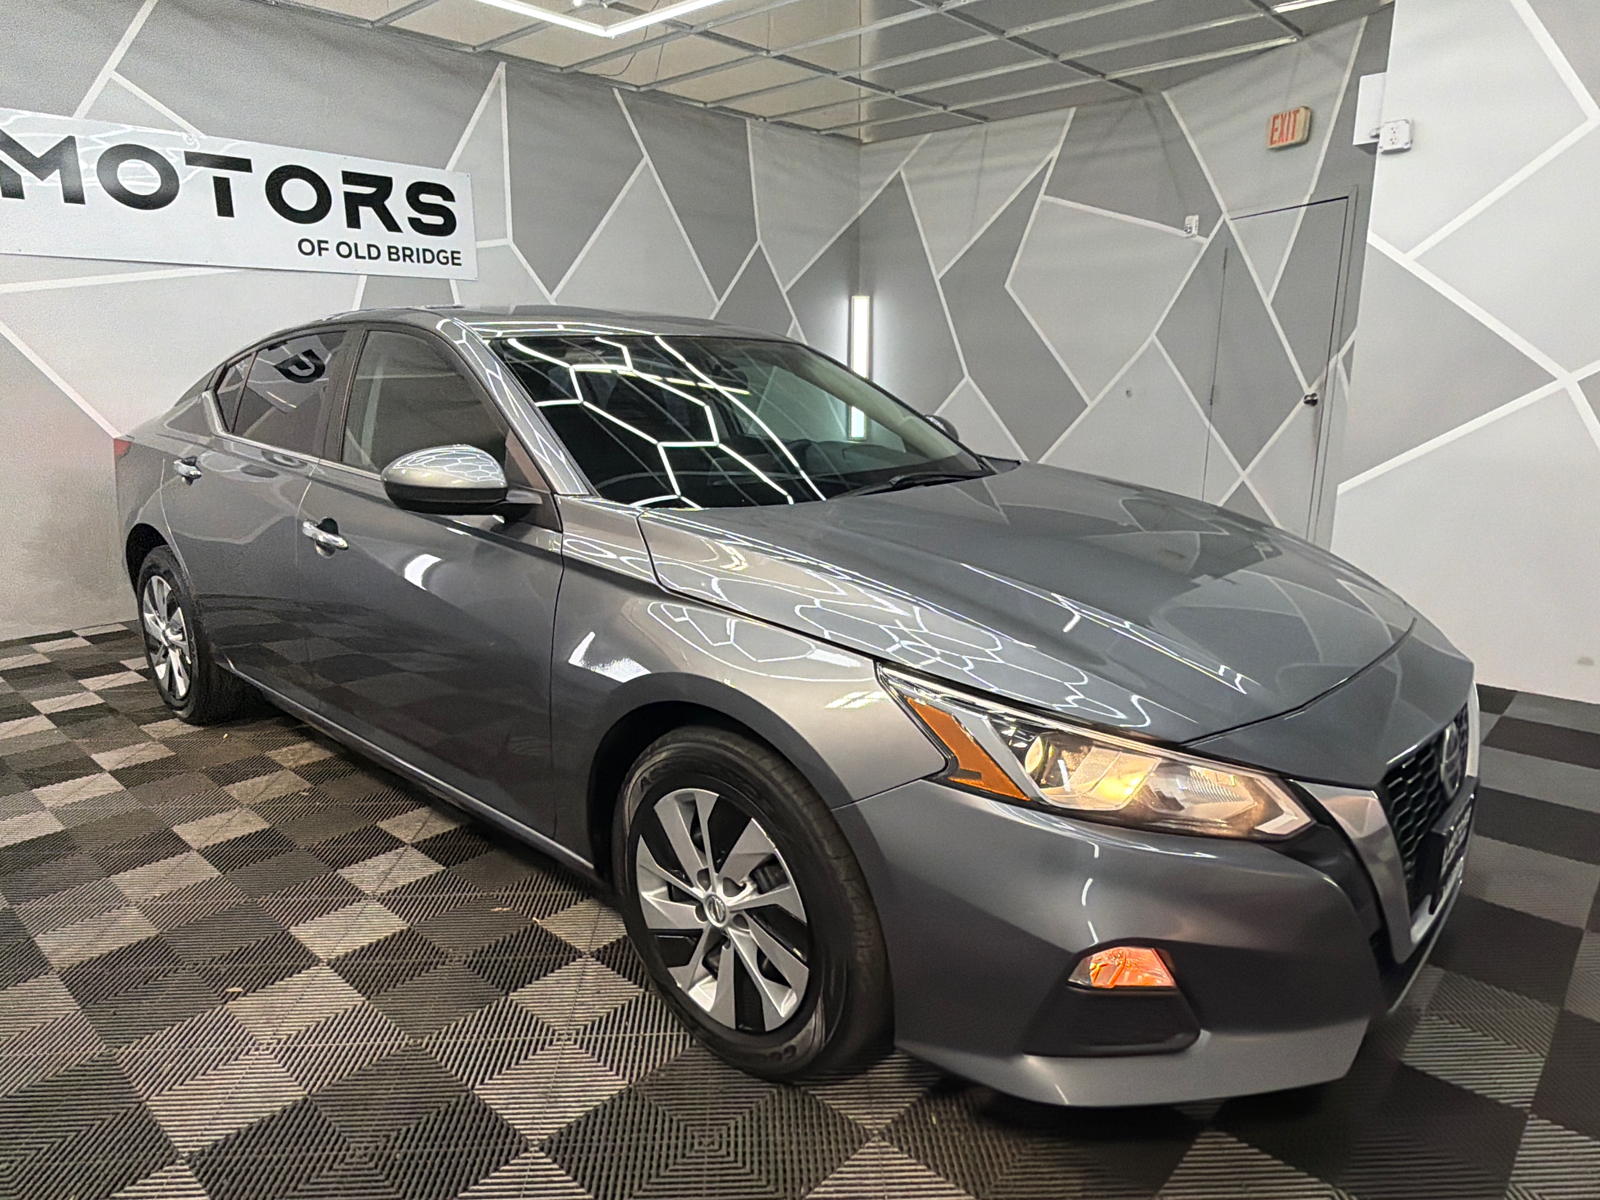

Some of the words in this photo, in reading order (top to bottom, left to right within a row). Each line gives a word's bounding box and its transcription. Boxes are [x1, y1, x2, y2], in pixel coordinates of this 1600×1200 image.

[1270, 110, 1299, 145] EXIT
[0, 128, 457, 237] MOTORS
[298, 238, 330, 257] OF
[336, 241, 381, 260] OLD
[388, 246, 462, 266] BRIDGE
